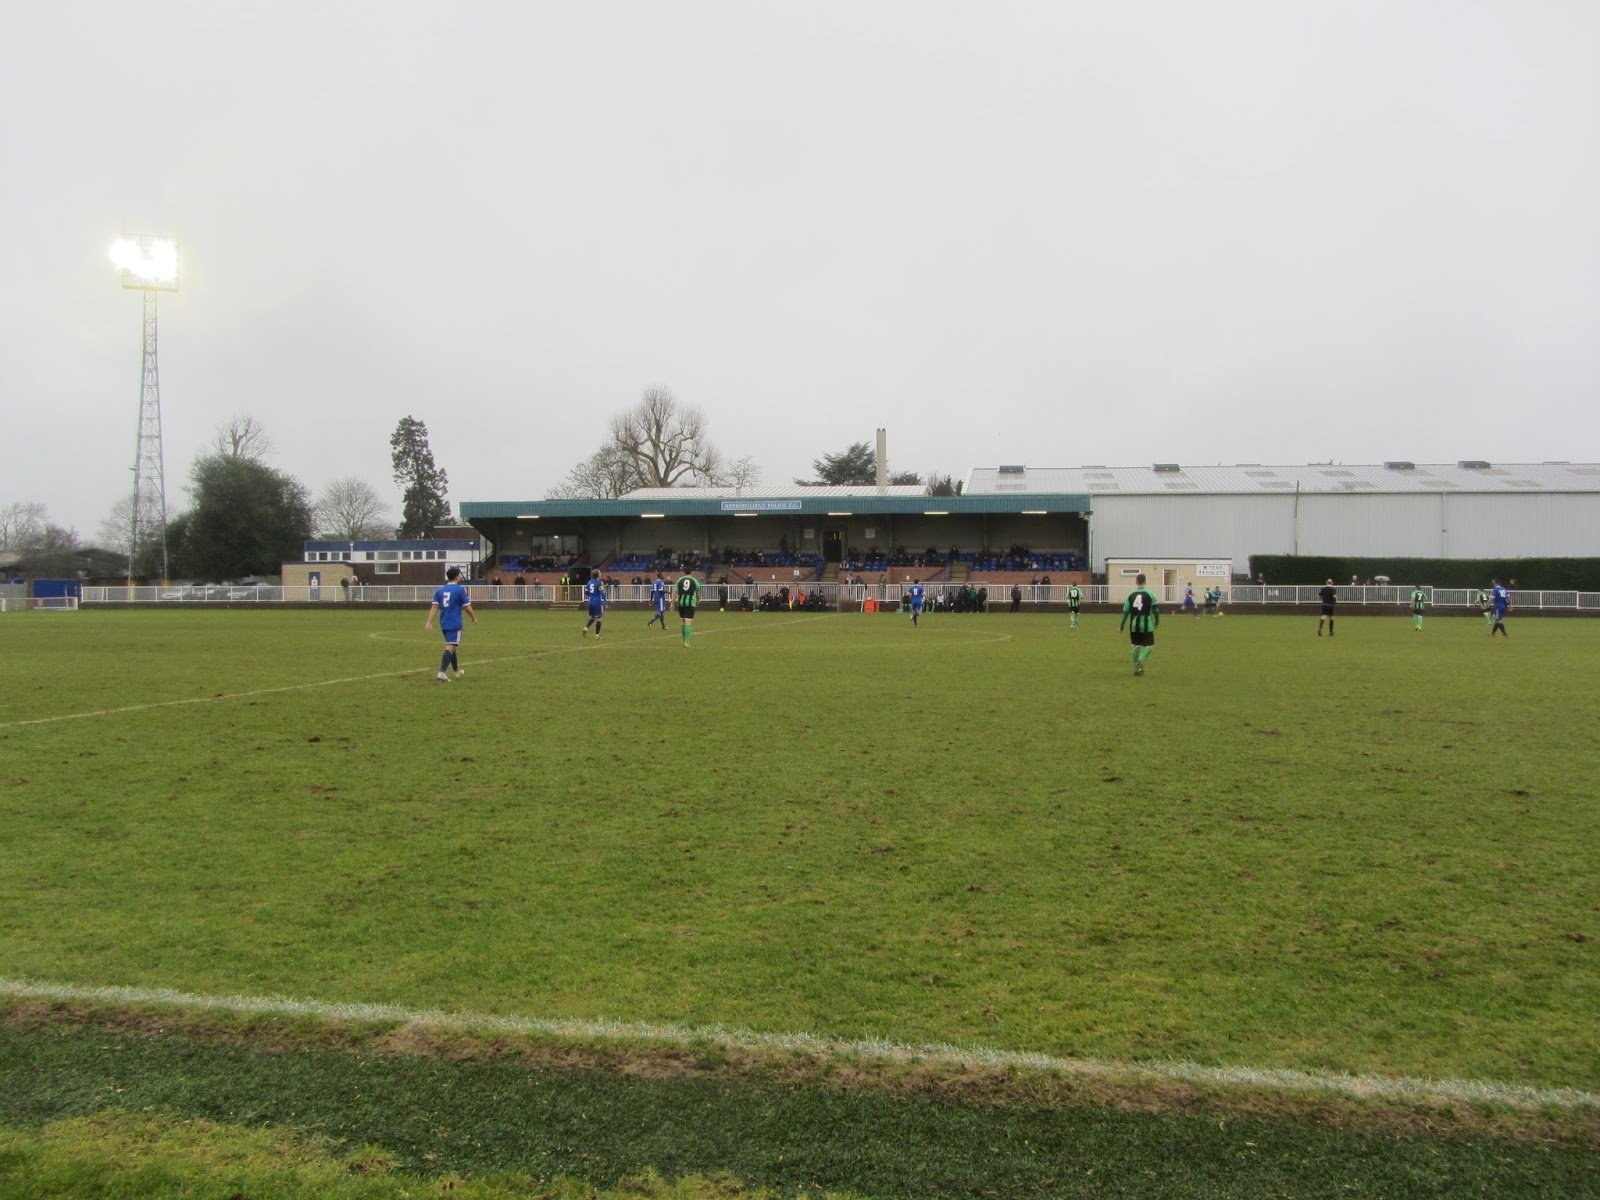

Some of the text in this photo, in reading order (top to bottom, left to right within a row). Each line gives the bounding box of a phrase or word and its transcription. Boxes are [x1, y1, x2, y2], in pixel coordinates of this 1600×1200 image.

[590, 584, 594, 594] 5
[683, 578, 690, 590] 9
[443, 592, 450, 608] 2
[1070, 590, 1078, 598] 10
[1133, 594, 1142, 610] 4
